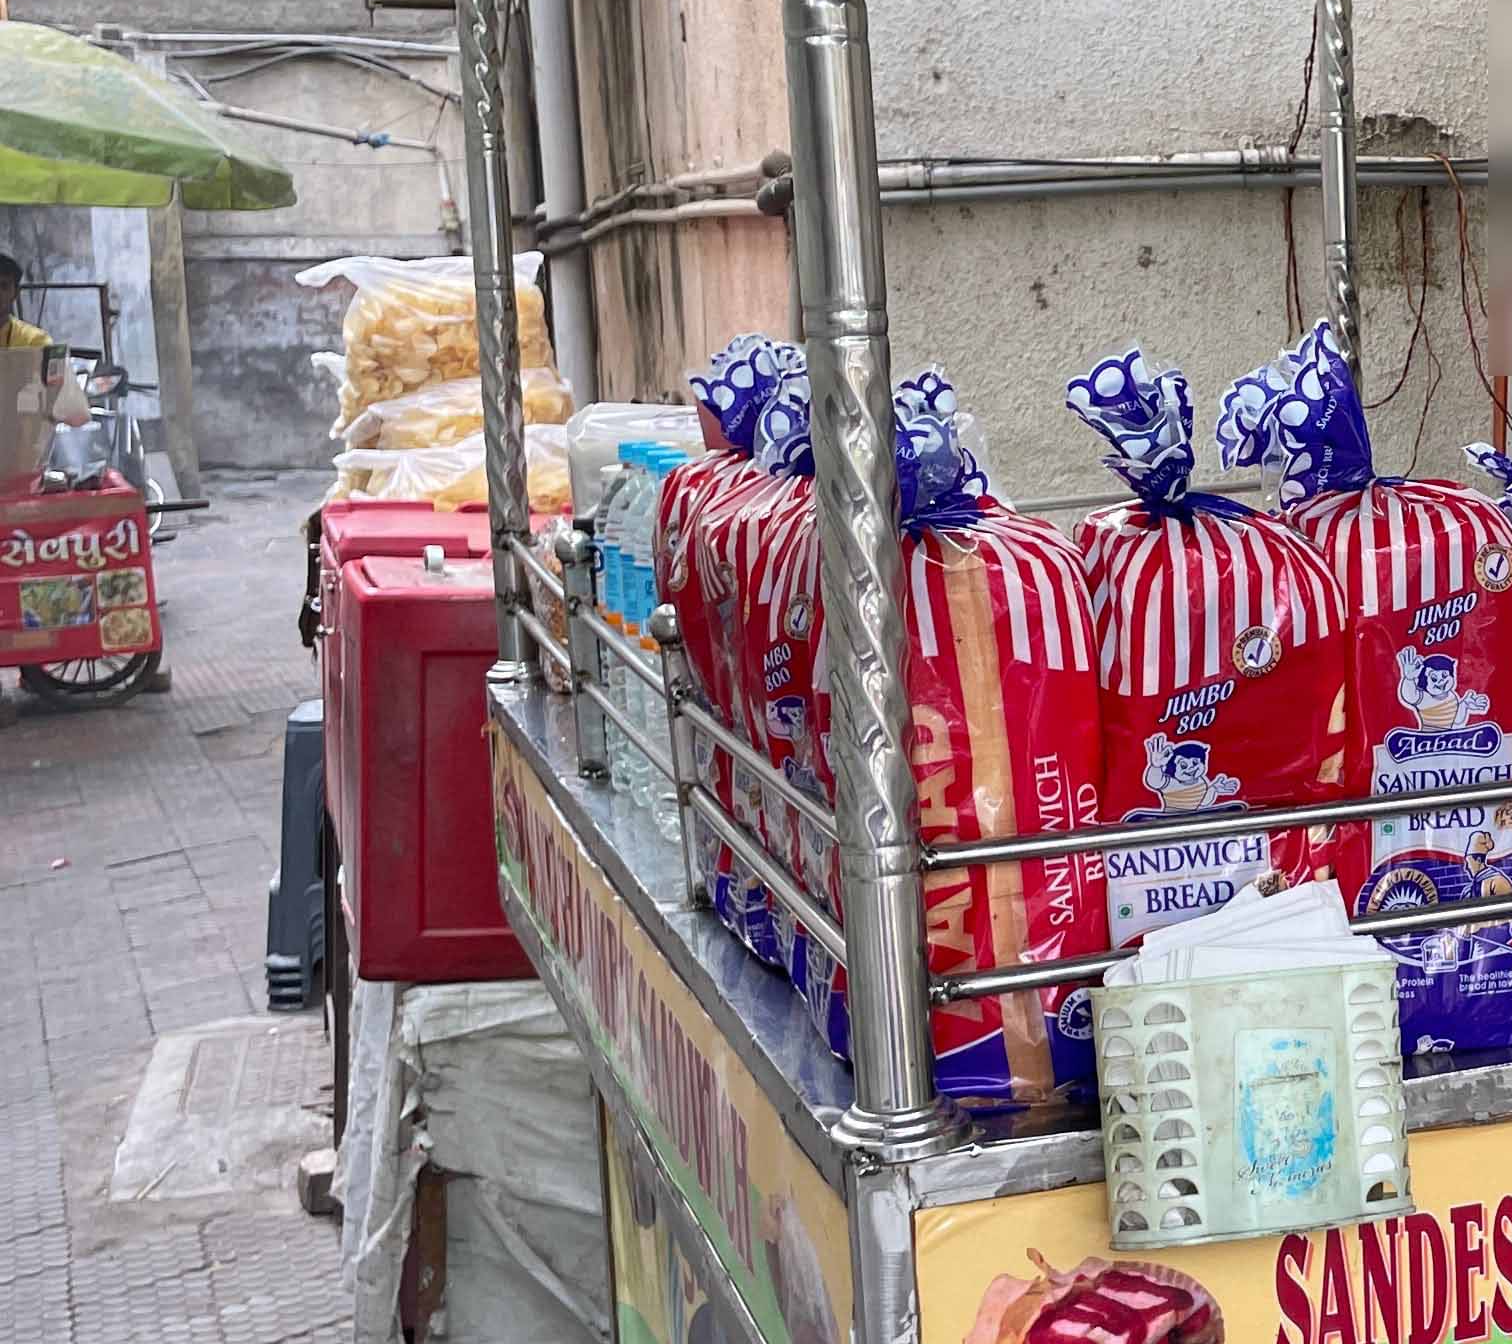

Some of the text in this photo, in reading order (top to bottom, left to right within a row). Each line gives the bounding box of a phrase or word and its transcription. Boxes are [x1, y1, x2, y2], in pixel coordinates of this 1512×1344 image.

[1408, 592, 1478, 635] JUMBO
[1424, 619, 1461, 646] 800
[764, 642, 792, 673] MBO
[764, 668, 791, 692] 800
[1158, 678, 1236, 723] JUMBO
[1176, 708, 1216, 735] 800
[1394, 730, 1493, 759] Aabad
[1376, 763, 1512, 796] SANDWICH
[1408, 807, 1486, 832] BREAD
[1107, 836, 1266, 880] SANDWICH
[1145, 879, 1236, 915] BREAD
[1402, 976, 1434, 987] Protein
[1459, 973, 1476, 983] The
[1060, 996, 1080, 1037] PREMIUM
